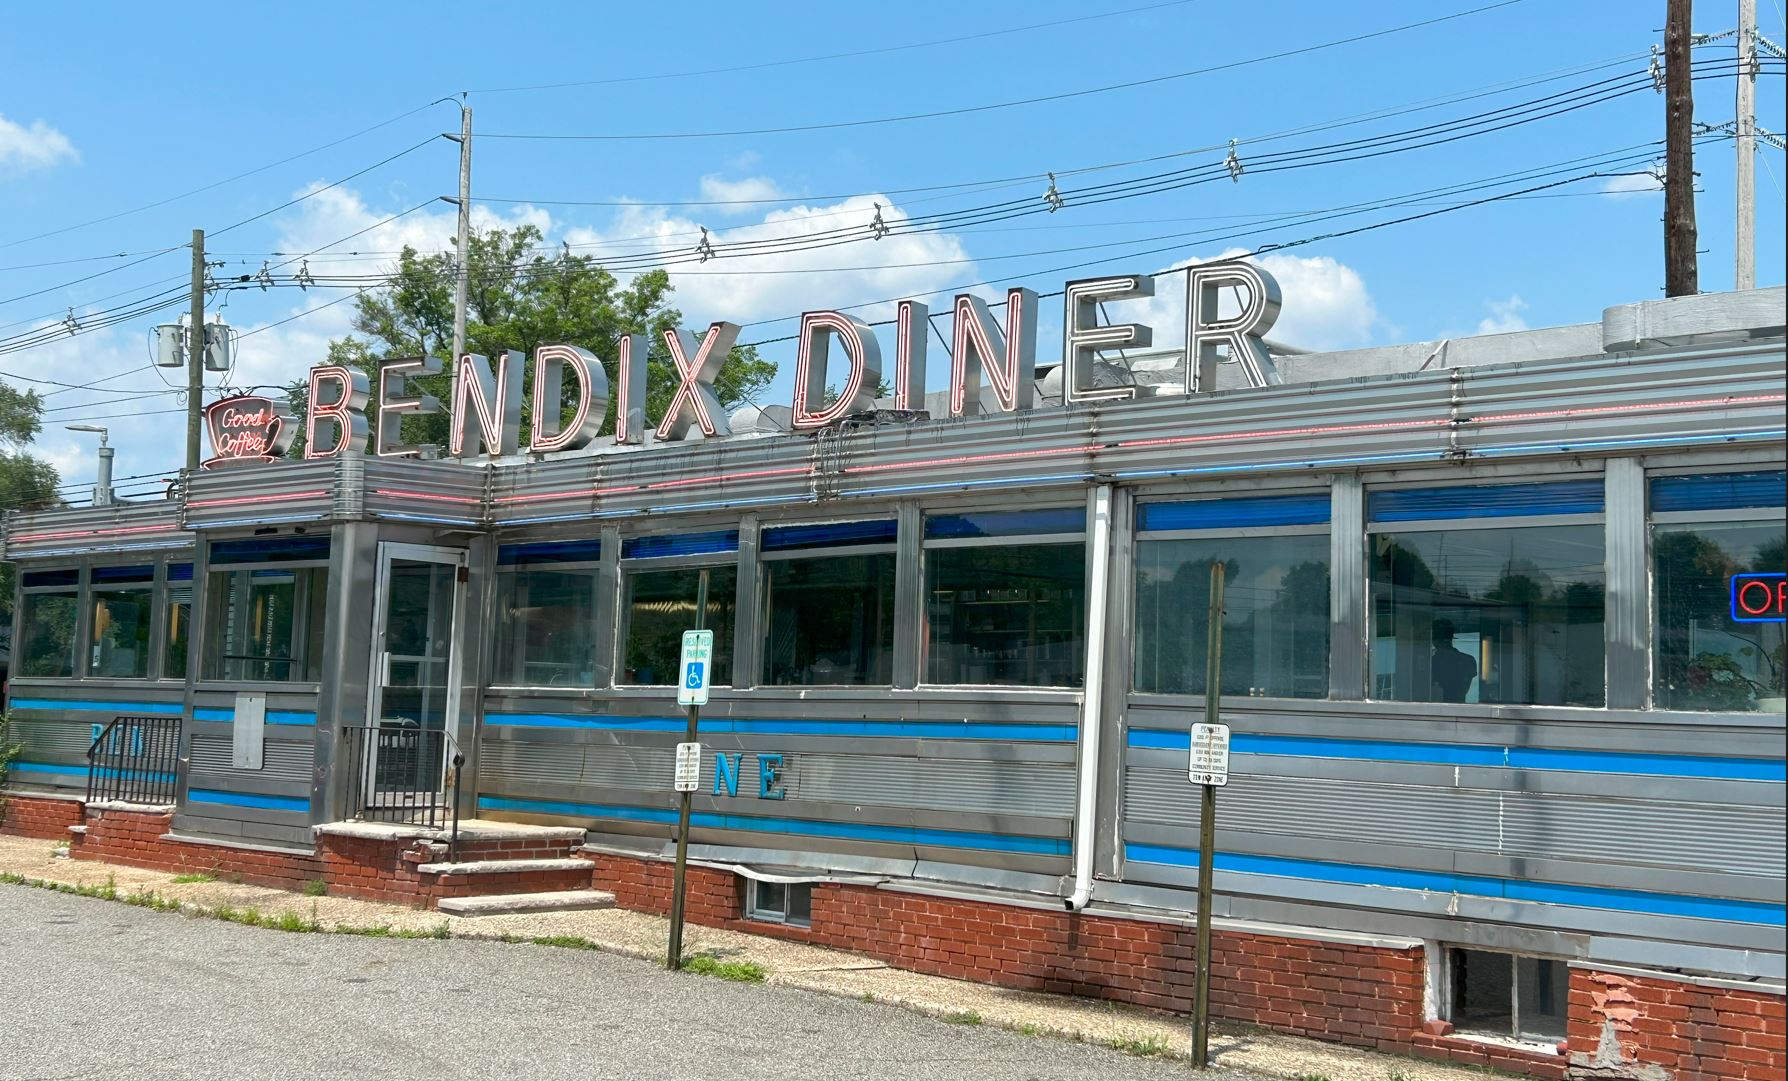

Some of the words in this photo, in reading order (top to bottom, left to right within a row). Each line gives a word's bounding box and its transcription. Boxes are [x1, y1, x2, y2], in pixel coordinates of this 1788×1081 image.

[304, 321, 741, 459] BENDIX
[791, 261, 1282, 429] DINER
[222, 408, 265, 428] Good
[219, 431, 264, 457] Coffee
